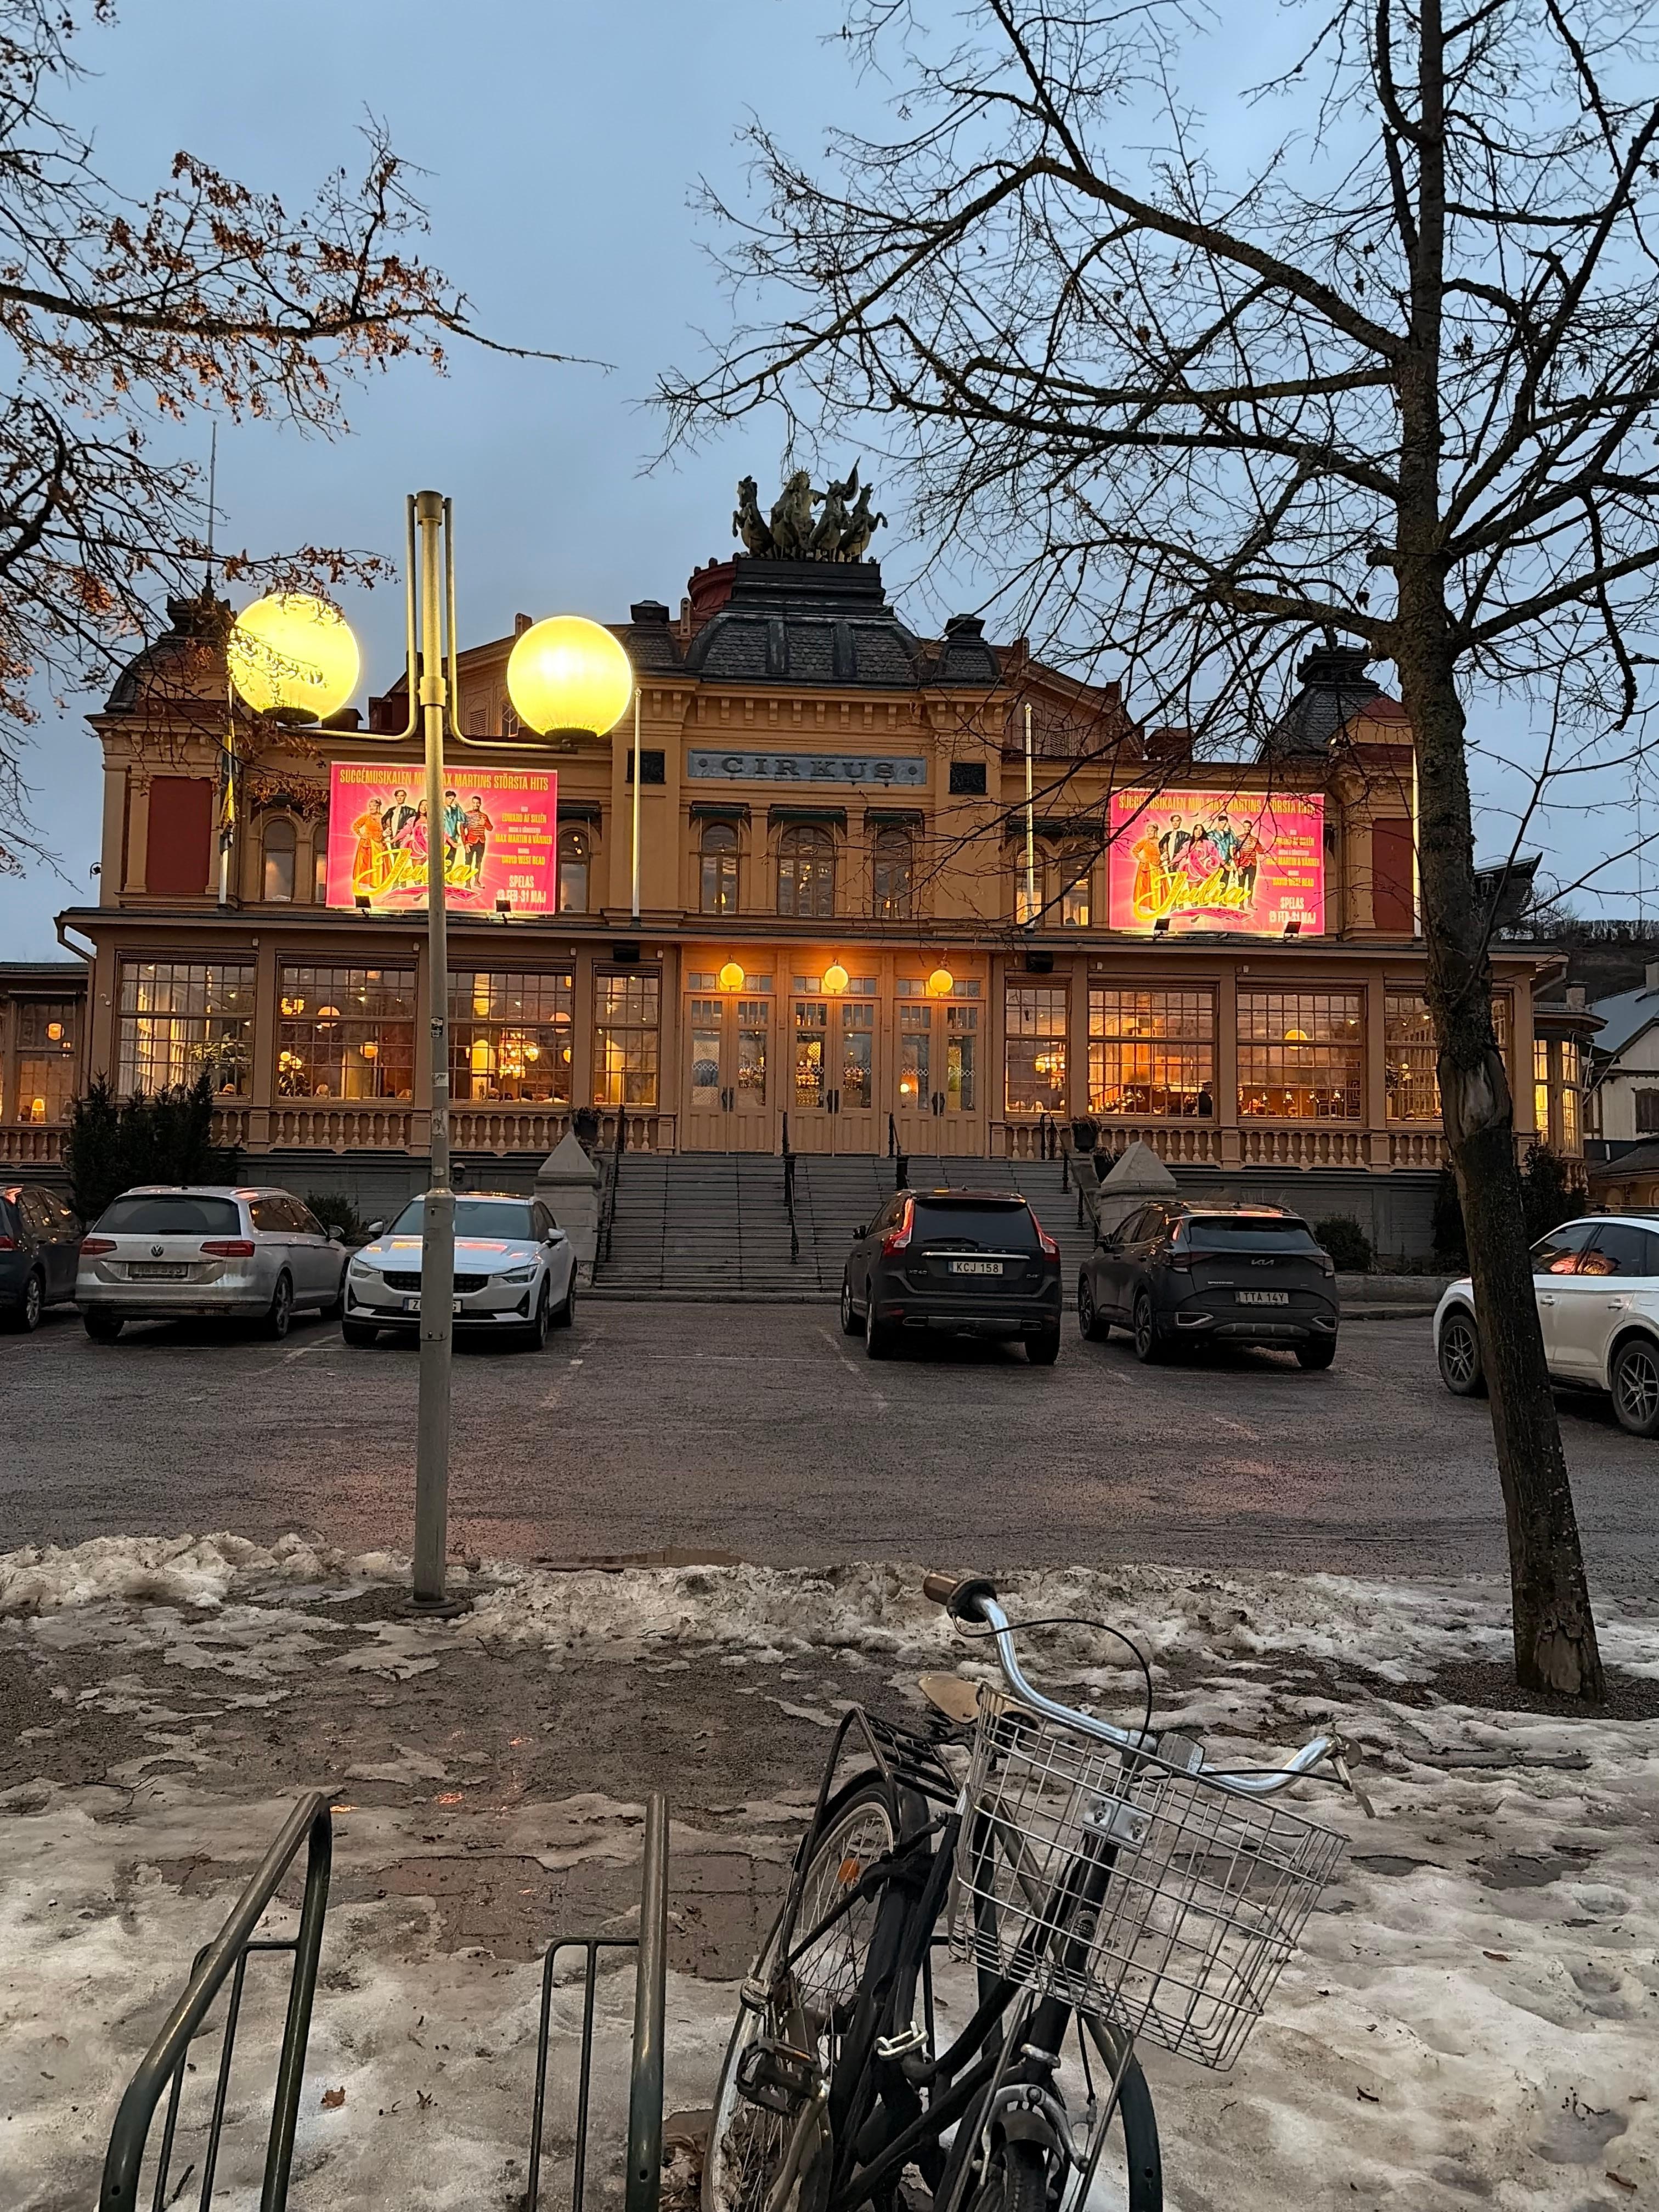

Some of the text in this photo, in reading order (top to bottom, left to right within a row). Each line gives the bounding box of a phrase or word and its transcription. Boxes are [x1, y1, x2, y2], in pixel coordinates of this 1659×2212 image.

[721, 757, 895, 779] CIRKUS
[340, 768, 411, 785] SUCCÉMUSIKALEN
[454, 773, 492, 789] MARTINS
[494, 773, 528, 791] STÖRSTA
[530, 777, 549, 791] HITS
[495, 833, 507, 843] MAX
[507, 834, 527, 843] MARTIN
[517, 855, 531, 865] WEST
[509, 874, 534, 888] SPELAS
[530, 890, 546, 904] MAJ
[1280, 896, 1305, 910] SPELAS
[1301, 912, 1316, 924] MAJ
[956, 1263, 999, 1273] KCJ 158
[1244, 1293, 1262, 1301] TTA
